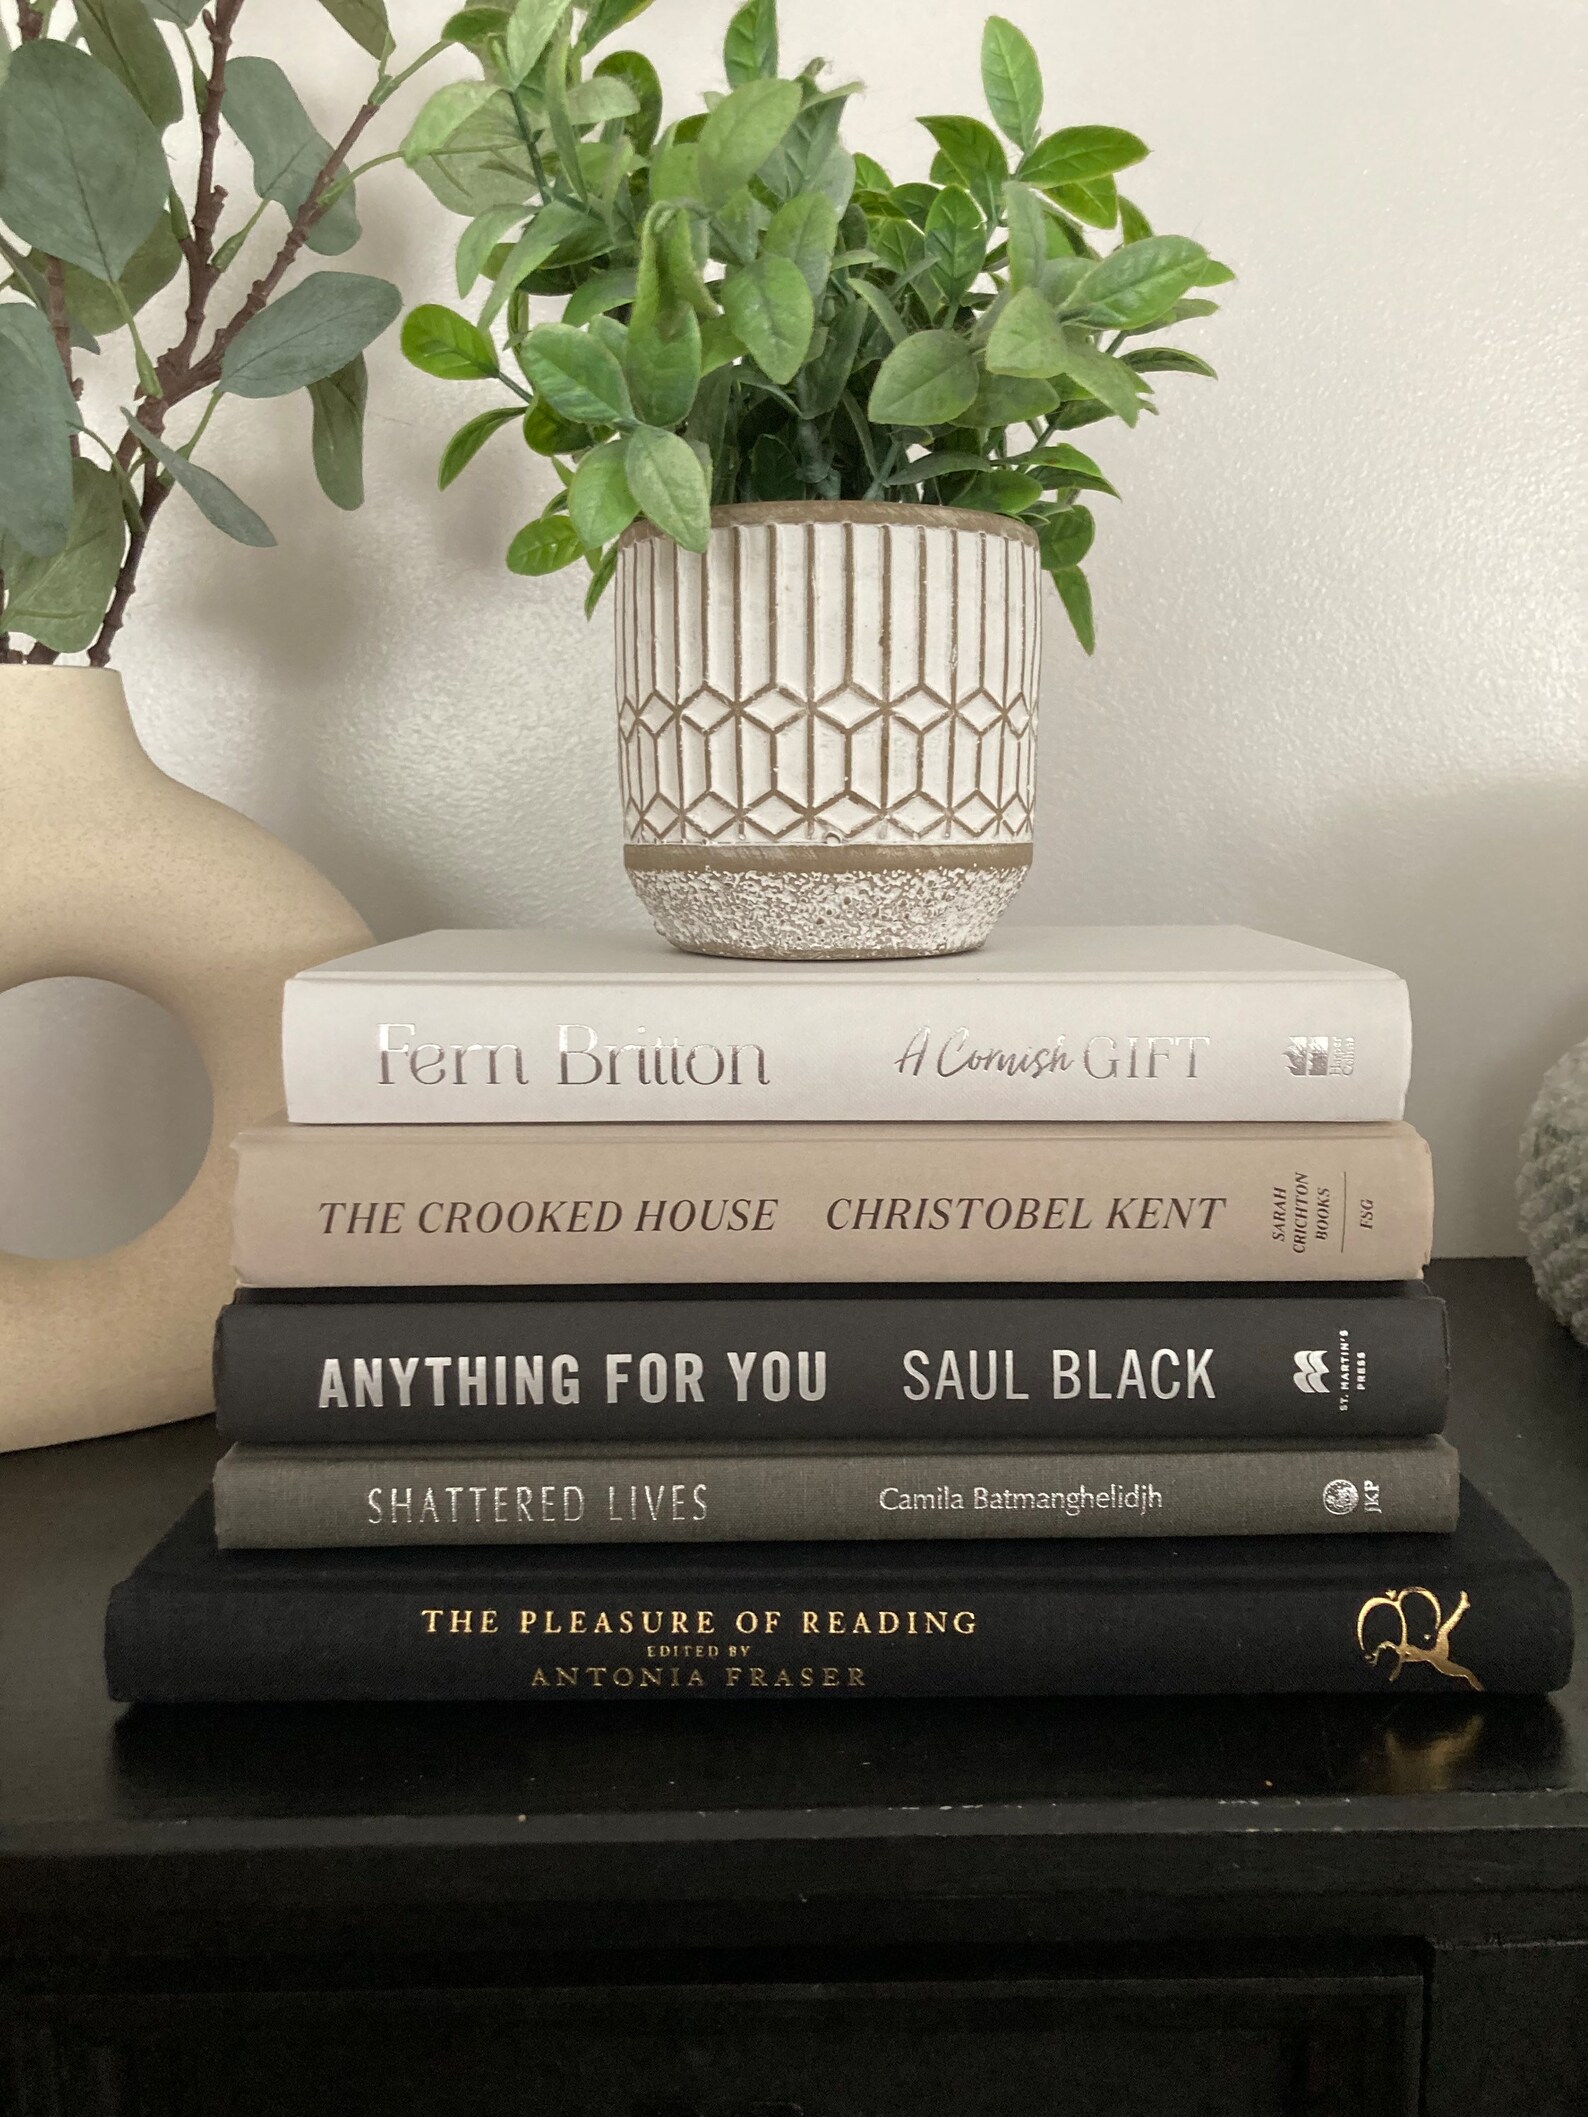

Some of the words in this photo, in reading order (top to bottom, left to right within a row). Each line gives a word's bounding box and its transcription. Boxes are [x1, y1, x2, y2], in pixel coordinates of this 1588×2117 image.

[376, 1023, 529, 1085] Fern
[556, 1023, 770, 1085] Britton
[894, 1026, 931, 1077] A
[936, 1026, 1075, 1079] Cornish
[1083, 1035, 1211, 1079] GIFT
[319, 1201, 405, 1234] THE
[418, 1201, 622, 1234] CROOKED
[634, 1199, 779, 1231] HOUSE
[827, 1197, 1093, 1230] CHRISTOBEL
[1105, 1197, 1227, 1229] KENT
[1272, 1187, 1287, 1242] SARAH
[1292, 1171, 1308, 1254] CRICHTON
[1316, 1187, 1330, 1240] BOOKS
[1360, 1199, 1374, 1229] FSG
[318, 1354, 580, 1408] ANYTHING
[606, 1352, 705, 1403] FOR
[726, 1350, 827, 1401] YOU
[903, 1349, 1030, 1400] SAUL
[1052, 1348, 1216, 1399] BLACK
[1339, 1330, 1350, 1390] MARTIN'S
[1356, 1352, 1366, 1390] PRESS
[1339, 1394, 1349, 1411] ST.
[368, 1486, 585, 1524] SHATTERED
[609, 1484, 708, 1521] LIVES
[879, 1485, 964, 1510] Camila
[973, 1483, 1163, 1516] Batmanghelidjh
[1363, 1480, 1382, 1513] JKP
[421, 1609, 499, 1634] THE
[520, 1609, 715, 1634] PLEASURE
[735, 1609, 781, 1634] OF
[803, 1610, 976, 1635] READING
[647, 1645, 719, 1658] EDITED
[728, 1645, 751, 1658] BY
[530, 1666, 705, 1687] ANTONIA
[725, 1667, 866, 1687] FRASER
